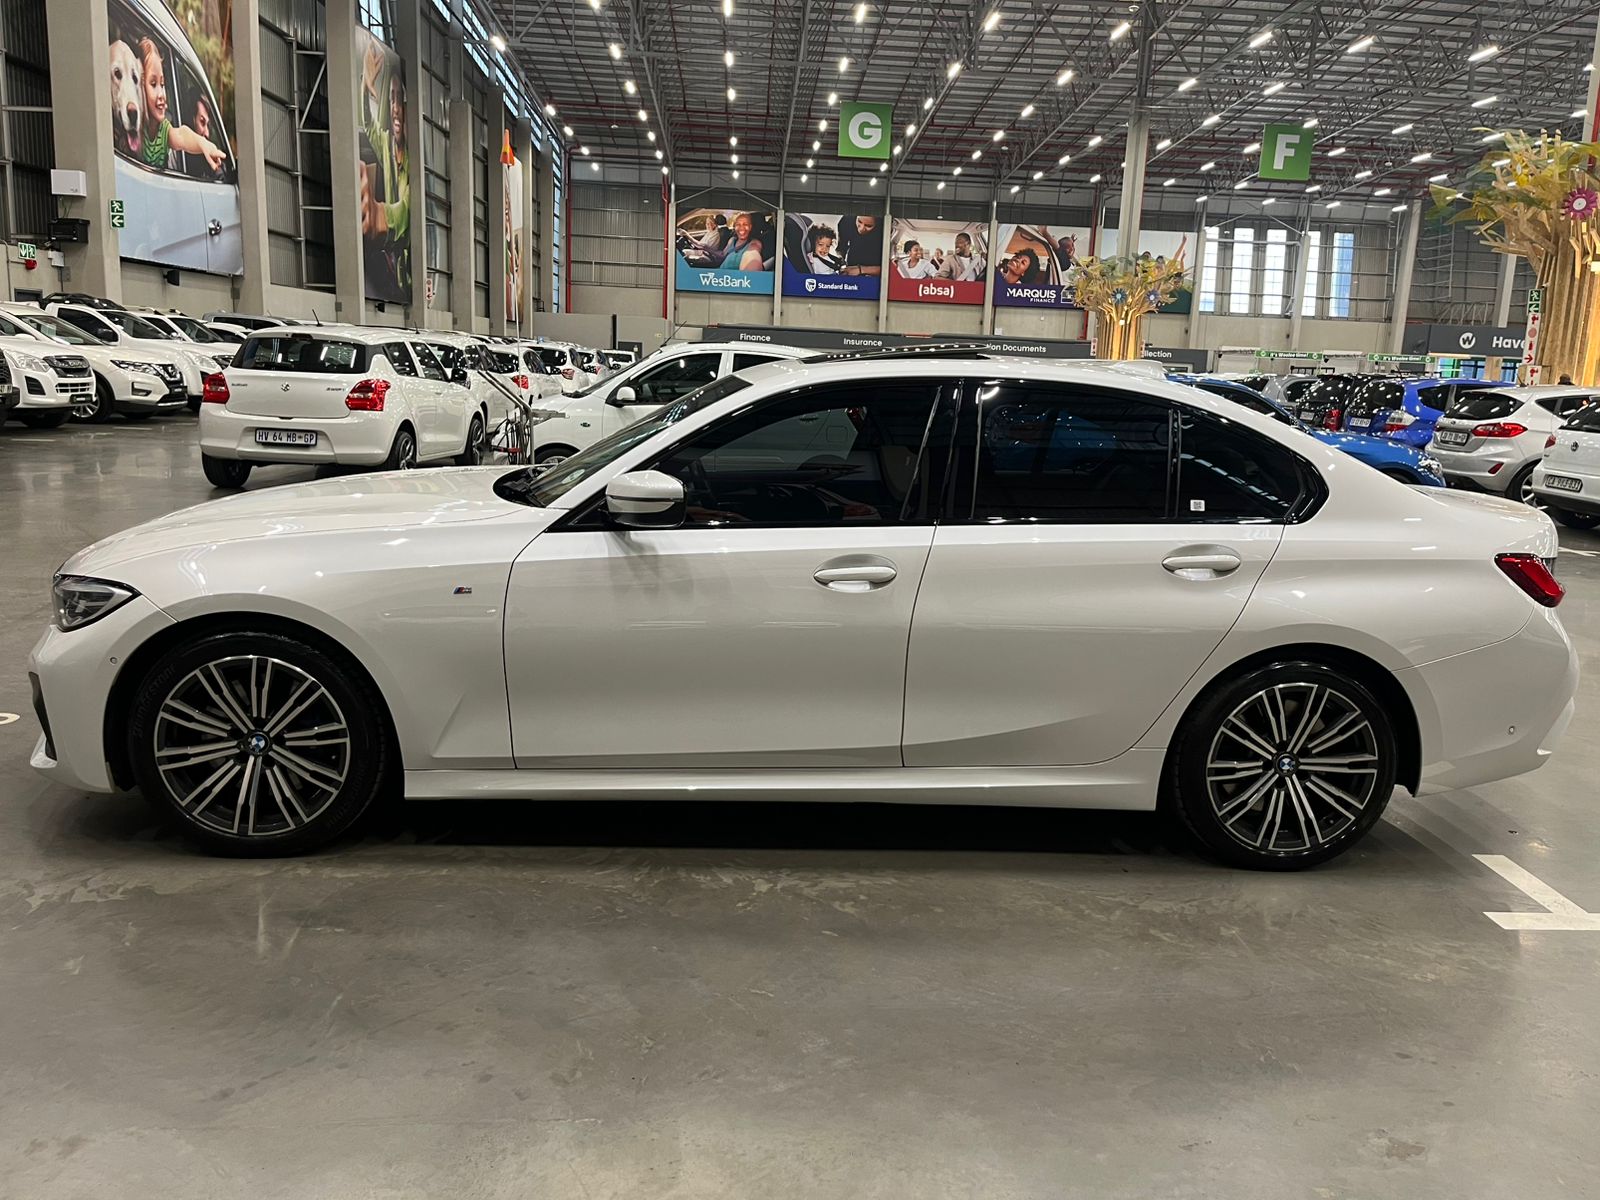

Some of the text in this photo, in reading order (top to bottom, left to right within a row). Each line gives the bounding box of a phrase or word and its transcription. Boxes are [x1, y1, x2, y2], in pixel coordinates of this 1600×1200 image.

[848, 111, 882, 149] G
[1273, 133, 1301, 170] F
[699, 273, 751, 288] WesBank
[817, 282, 843, 291] Standard
[1006, 287, 1057, 299] MARQUIS
[739, 333, 771, 341] Finance
[843, 338, 882, 347] Insurance
[1002, 344, 1047, 353] Documents
[257, 431, 269, 441] HV
[272, 432, 283, 441] 64
